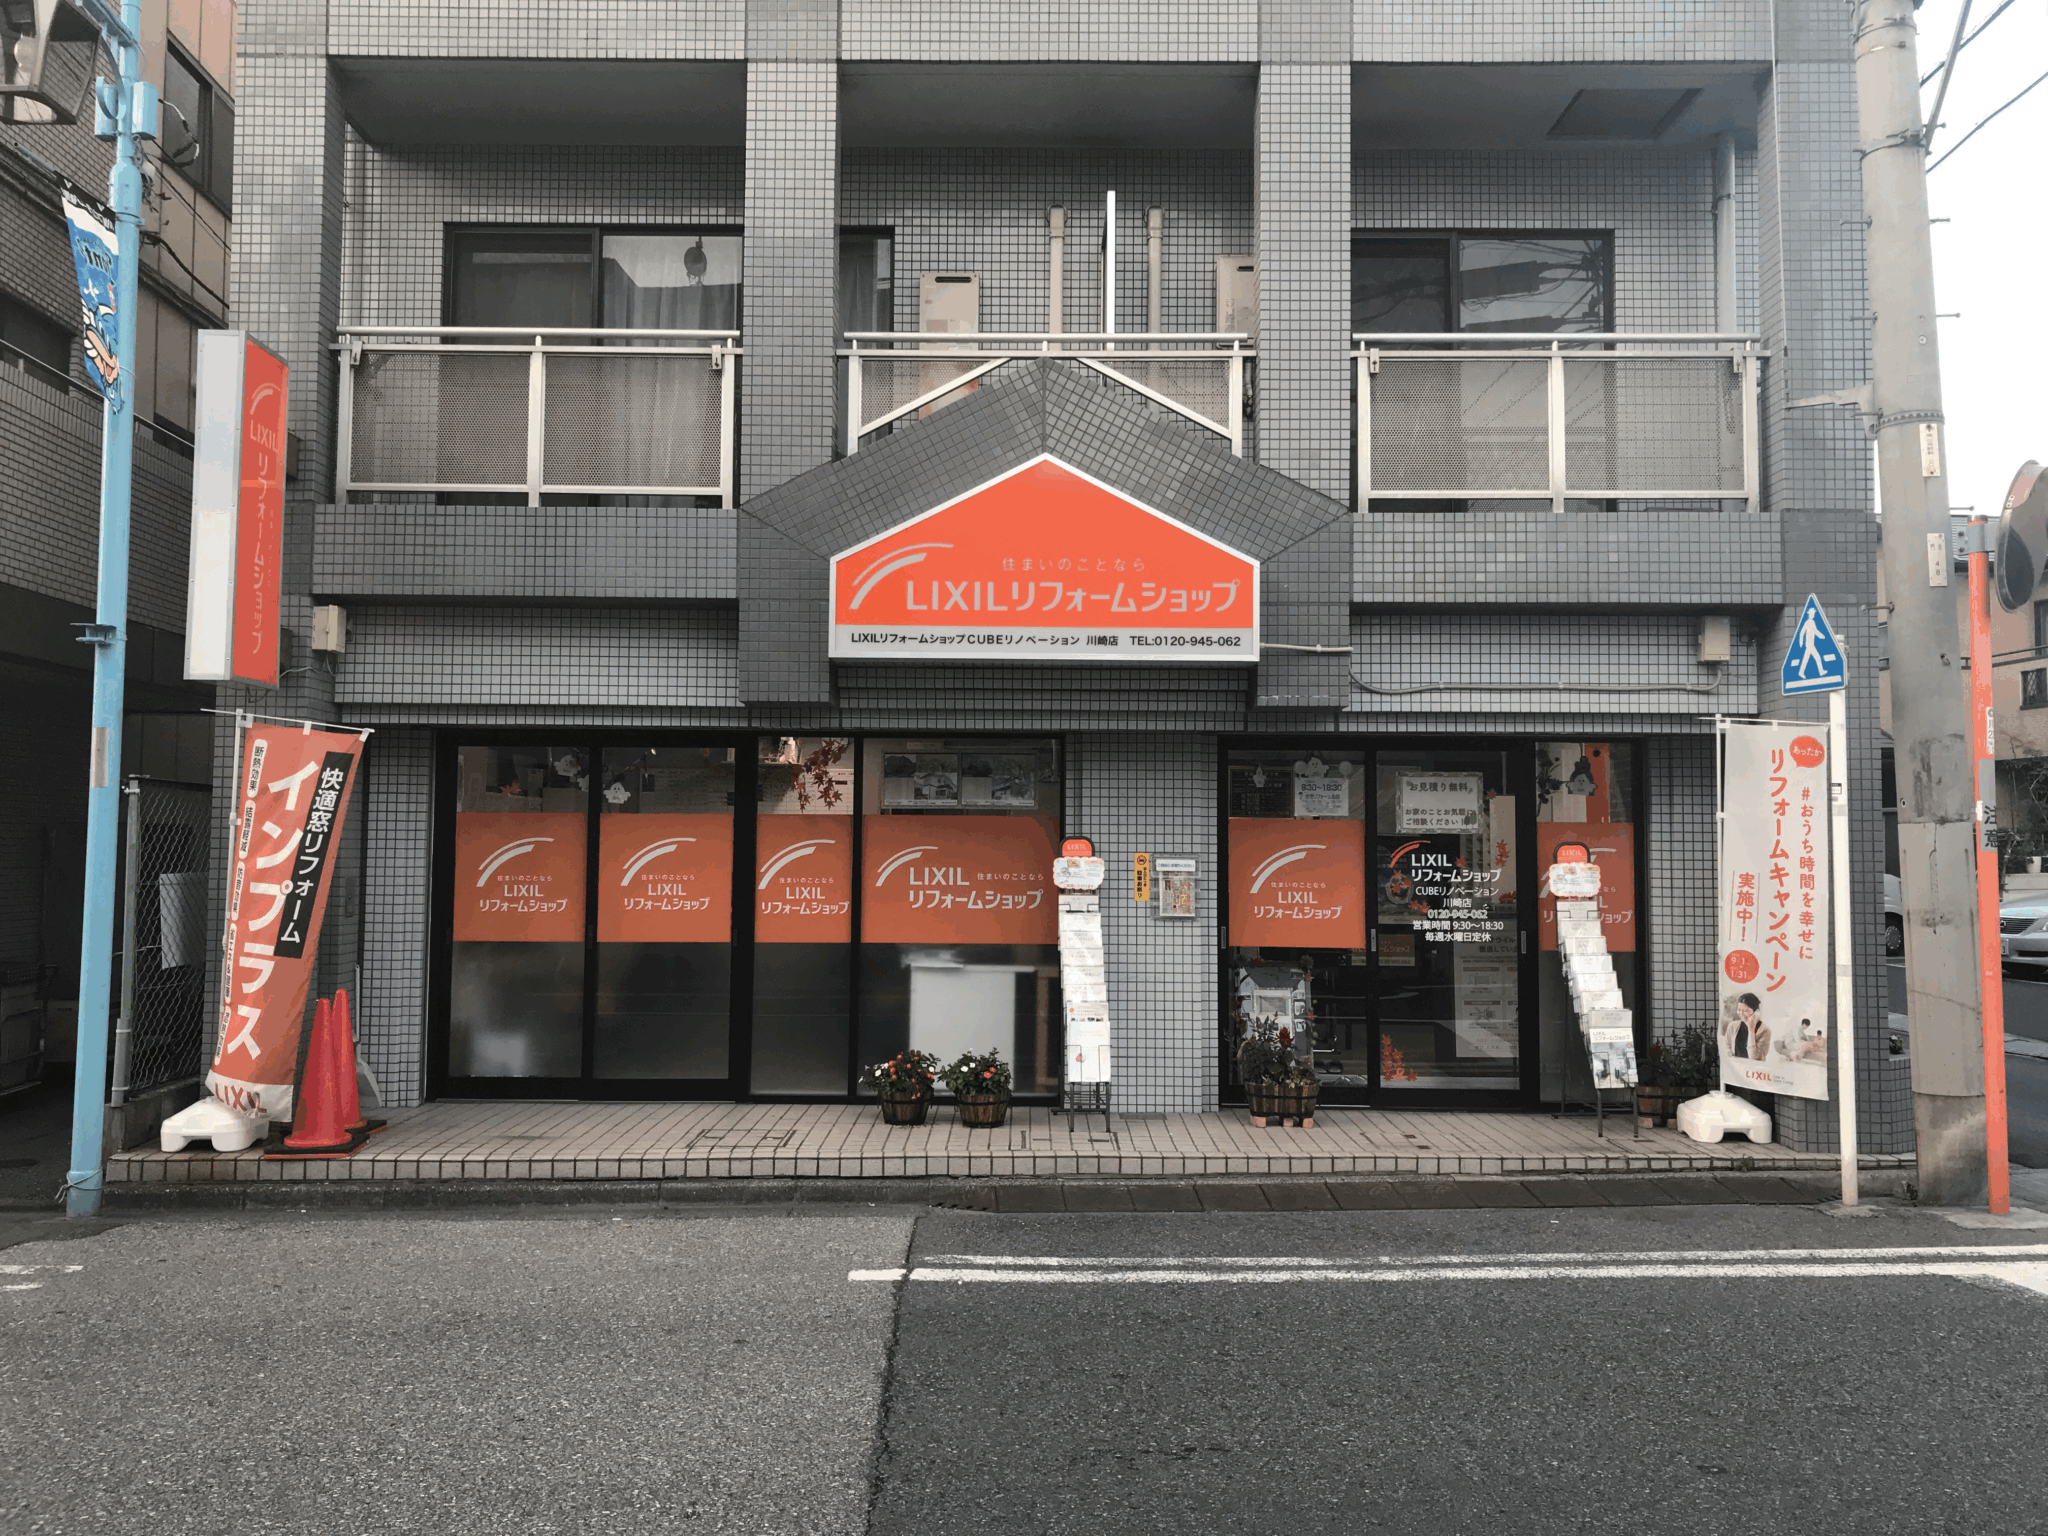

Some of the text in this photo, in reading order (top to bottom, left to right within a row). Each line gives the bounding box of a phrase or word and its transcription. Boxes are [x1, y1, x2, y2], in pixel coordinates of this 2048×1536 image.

[250, 419, 279, 454] LIXIL
[252, 452, 269, 654] リフォームショップ
[1002, 557, 1146, 573] 住まいのことなら
[906, 578, 1242, 613] LIXILリフォームショップ
[1086, 635, 1119, 647] 川崎店
[1130, 636, 1242, 648] TEL:0120-945-062
[1793, 746, 1823, 758] あったか
[1409, 782, 1468, 792] お見積り無料
[1405, 808, 1472, 816] お家のことお気軽に
[280, 766, 344, 944] 快適窓リフォーム
[1411, 854, 1452, 867] LIXIL
[909, 867, 1044, 886] LIXIL 住まいのことなら
[1411, 868, 1502, 882] リフォームショップ
[1765, 749, 1791, 992] リフォームキャンペーン
[1799, 786, 1815, 960] #おうち時間を幸せに
[504, 884, 544, 897] LIXIL
[648, 883, 687, 896] LIXIL
[786, 887, 825, 899] LIXIL
[1415, 886, 1499, 896] CUBEリノベーション
[624, 897, 710, 911] リフォームショップ
[909, 888, 1044, 909] リフォームショップ
[1278, 892, 1318, 904] LIXIL
[1443, 898, 1472, 908] 川崎店
[227, 760, 319, 1060] インプラス
[480, 898, 568, 912] リフォームショップ
[762, 900, 850, 915] リフォームショップ
[1254, 905, 1343, 920] リフォームショップ
[1427, 909, 1489, 919] 0120-945-062
[1413, 920, 1450, 930] 営業時間
[1425, 932, 1492, 942] 毎週水曜日定休
[1745, 1070, 1772, 1082] LIXIL
